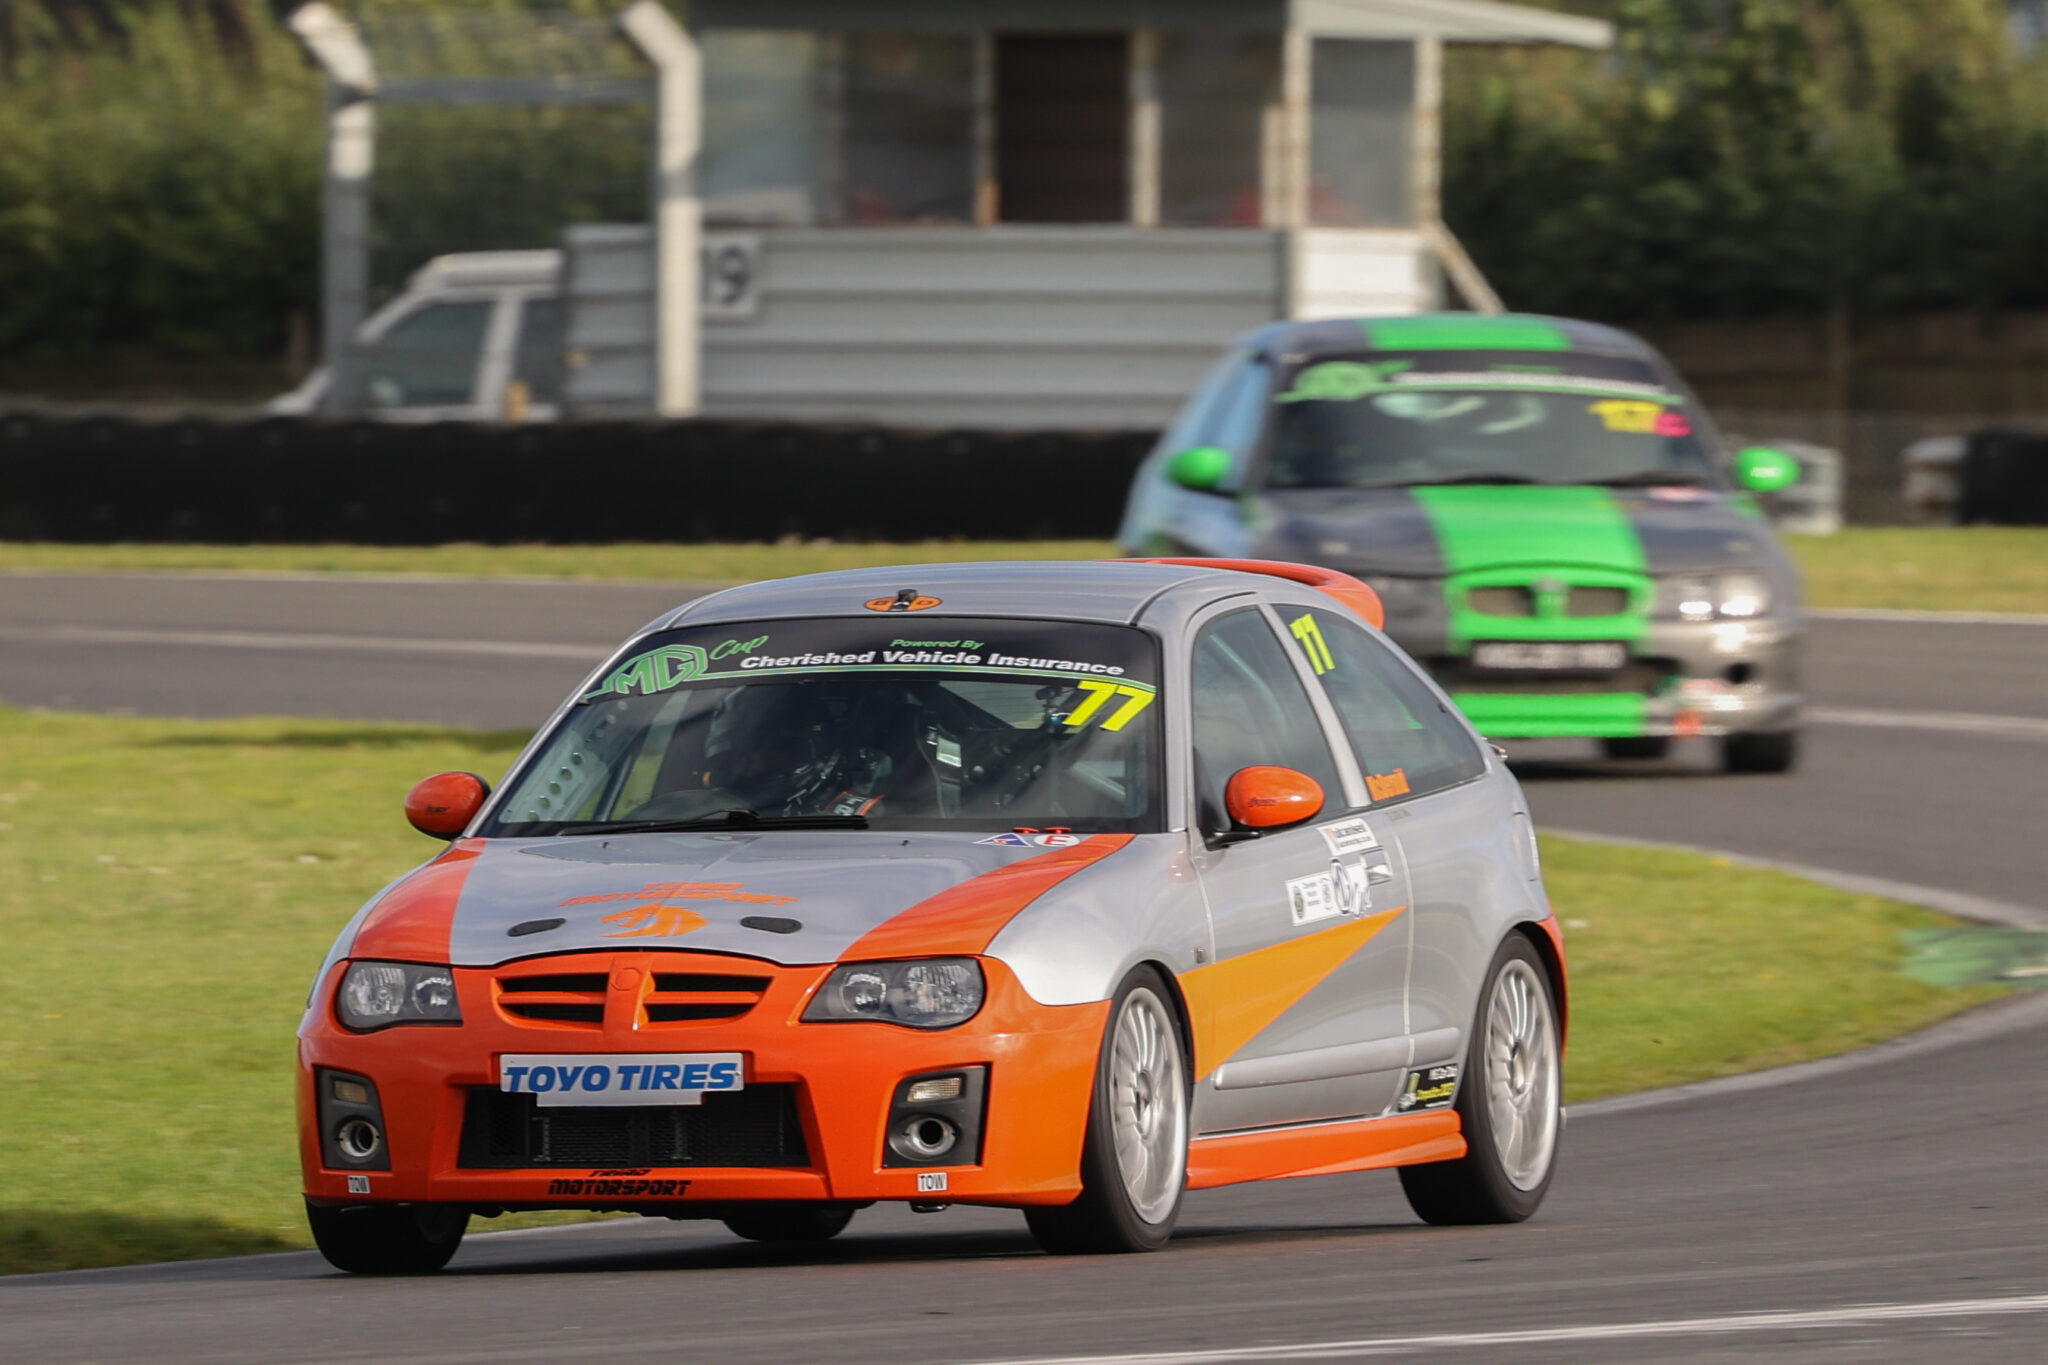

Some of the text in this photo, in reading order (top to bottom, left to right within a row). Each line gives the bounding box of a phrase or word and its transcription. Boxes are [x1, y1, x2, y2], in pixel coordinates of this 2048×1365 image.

[889, 638, 985, 650] Powered By
[609, 635, 769, 695] MG Cup
[740, 650, 1125, 675] Cherished Vehicle Insurance
[1062, 680, 1156, 731] 77
[503, 1062, 738, 1093] TOYO TIRES
[548, 1179, 692, 1197] MOTORSPORT
[920, 1174, 946, 1190] TOW
